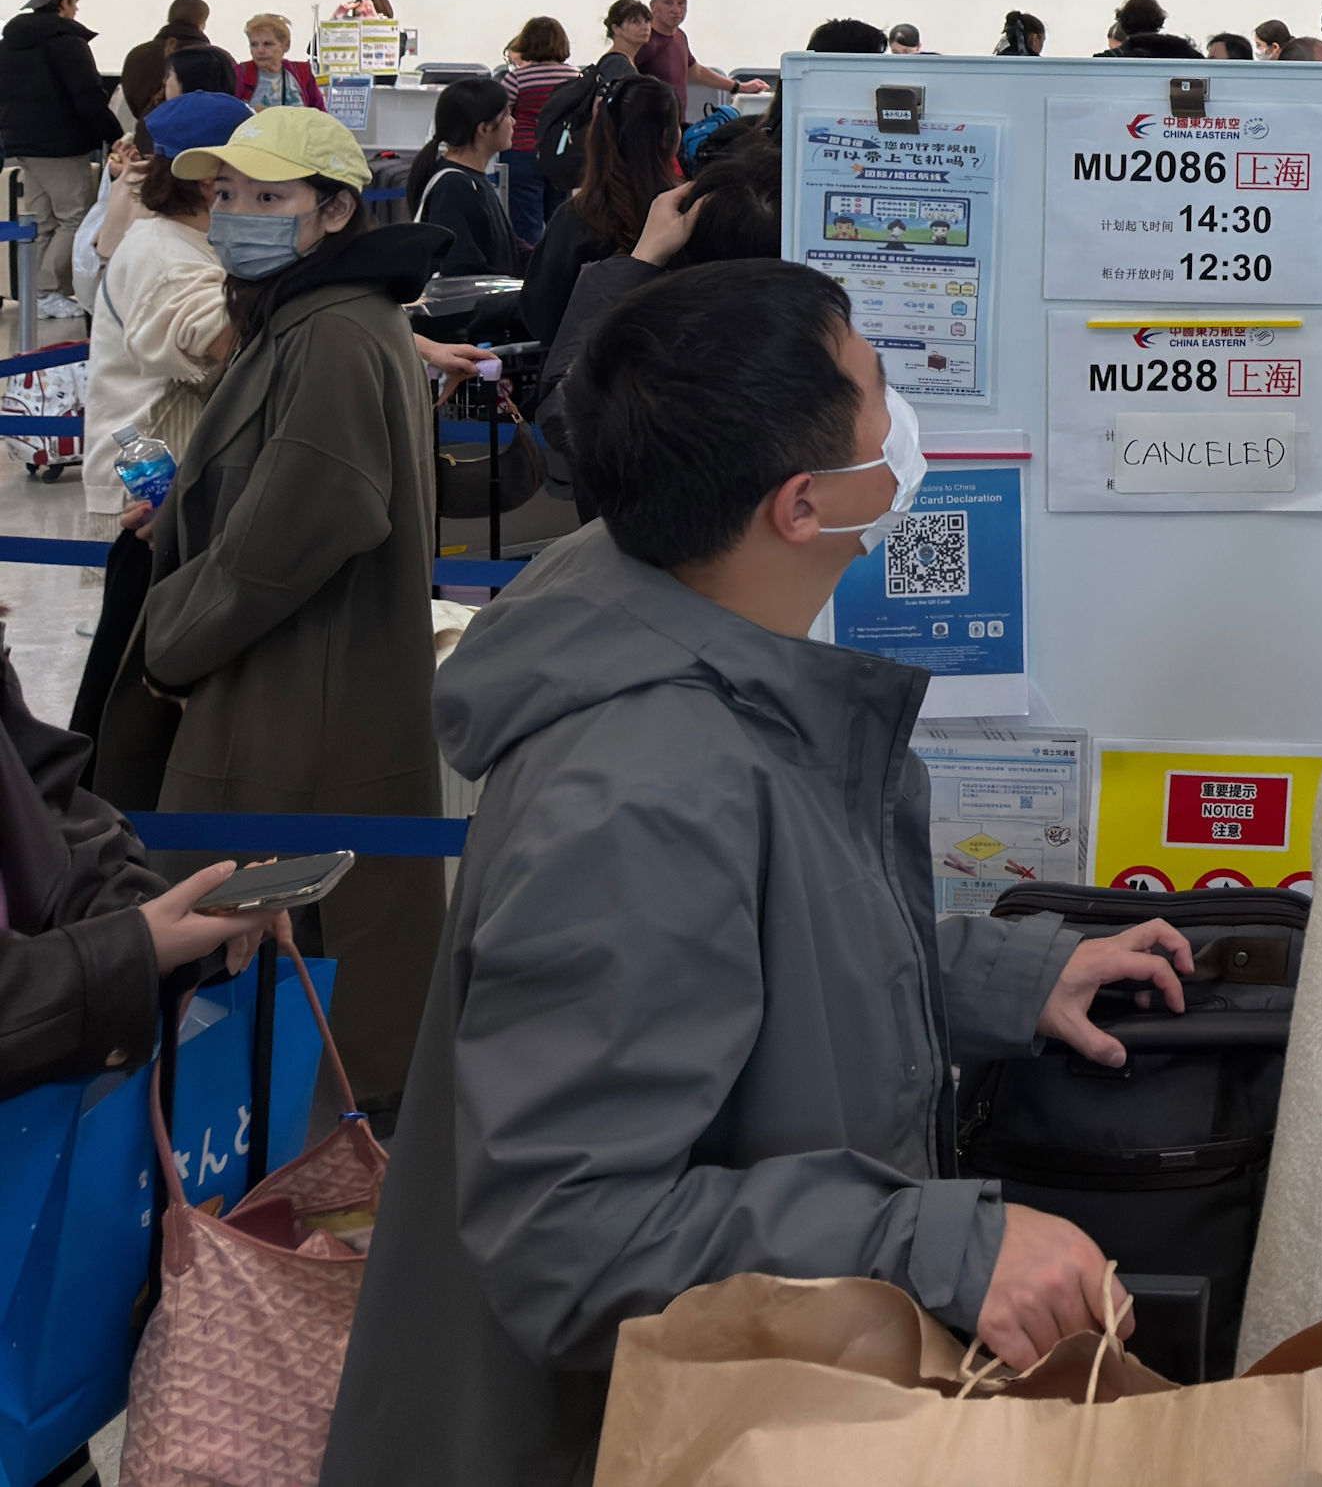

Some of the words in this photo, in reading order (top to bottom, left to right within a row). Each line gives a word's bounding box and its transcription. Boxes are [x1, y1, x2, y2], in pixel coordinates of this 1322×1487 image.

[1163, 116, 1240, 129] 中國東方航空
[1163, 130, 1193, 139] CHINA
[1196, 131, 1240, 140] EASTERN
[1074, 150, 1226, 183] MU2086
[1240, 156, 1305, 188] 上海
[1101, 219, 1173, 233] 计划起飞时间
[1179, 204, 1272, 234] 14:30
[1101, 268, 1174, 281] 柜台开放时间
[1180, 253, 1272, 282] 12:30
[1169, 339, 1199, 347] CHINA
[1202, 339, 1246, 347] EASTERN
[1090, 360, 1216, 392] MU288
[1232, 363, 1296, 394] 上海
[1124, 438, 1285, 468] CANCELED
[954, 483, 975, 491] China
[920, 495, 943, 504] Card
[946, 494, 1002, 504] Declaration
[1202, 783, 1256, 799] 重要提示
[1203, 804, 1253, 818] NOTICE
[1213, 823, 1241, 838] 注意
